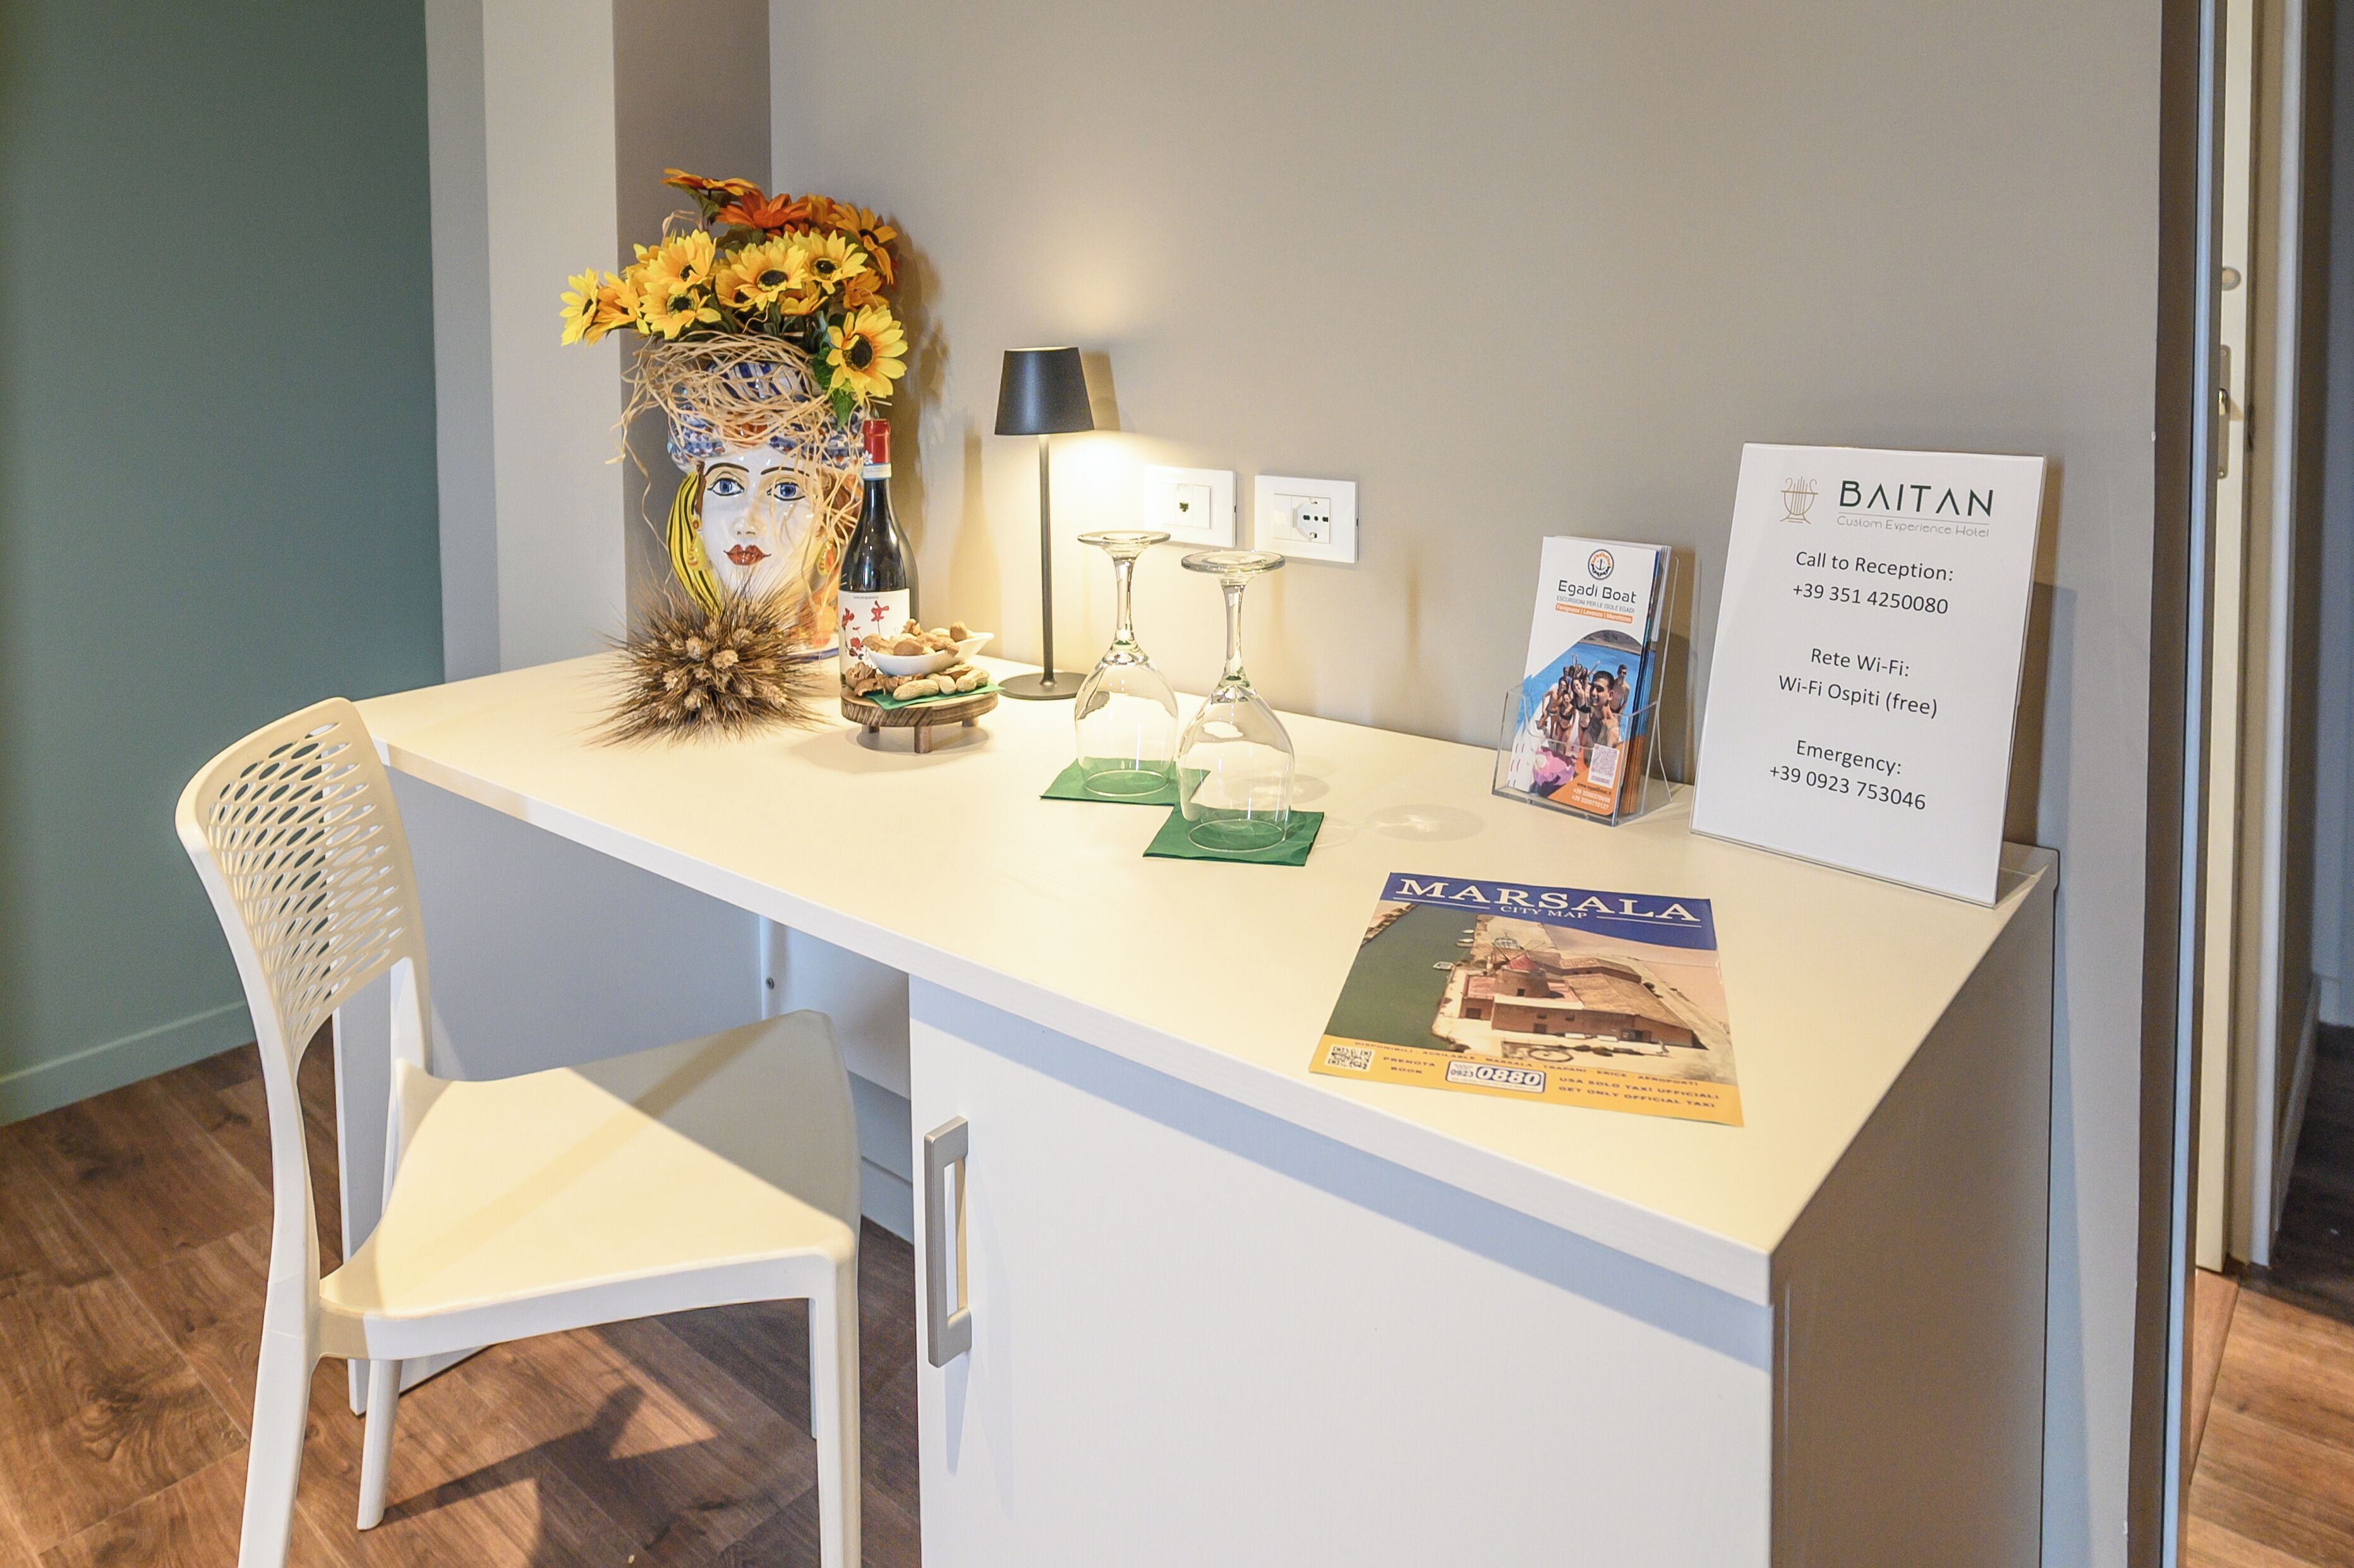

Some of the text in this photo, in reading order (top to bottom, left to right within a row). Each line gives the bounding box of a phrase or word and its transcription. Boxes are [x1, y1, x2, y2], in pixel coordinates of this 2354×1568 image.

[1839, 480, 1993, 517] BAITAN
[1837, 516, 1989, 537] Custom Experience Hotel
[1796, 552, 1953, 581] Call to Reception:
[1557, 595, 1585, 605] ESCURSIONI
[1604, 603, 1618, 611] ISOLE
[1558, 579, 1637, 603] Egadi Boat
[1793, 583, 1948, 614] +39 351 4250080
[1811, 648, 1909, 677] Rete Wi-Fi:
[1779, 675, 1938, 719] Wi-Fi Ospiti (free)
[1797, 740, 1902, 776] Emergency:
[1770, 766, 1926, 810] +39 0923 753046
[1396, 879, 1701, 922] MARSALA
[1500, 905, 1588, 919] CITY MAP
[1355, 1042, 1413, 1053] DISPONIBILI
[1423, 1051, 1475, 1060] AVAILABLE
[1485, 1058, 1533, 1067] MARSALA
[1543, 1064, 1586, 1073] TRAPANI
[1638, 1075, 1699, 1086] AEROPORTI
[1383, 1056, 1435, 1067] PRENOTA
[1391, 1066, 1422, 1075] BOOK
[1450, 1068, 1474, 1077] 0923
[1476, 1066, 1541, 1086] 0880
[1587, 1089, 1619, 1097] ONLY
[1624, 1094, 1681, 1104] OFFICIAL
[1686, 1100, 1716, 1108] TAXI
[1588, 1080, 1621, 1089] SOLO
[1625, 1084, 1653, 1092] TAXI
[1657, 1089, 1719, 1100] UFFICIALI
